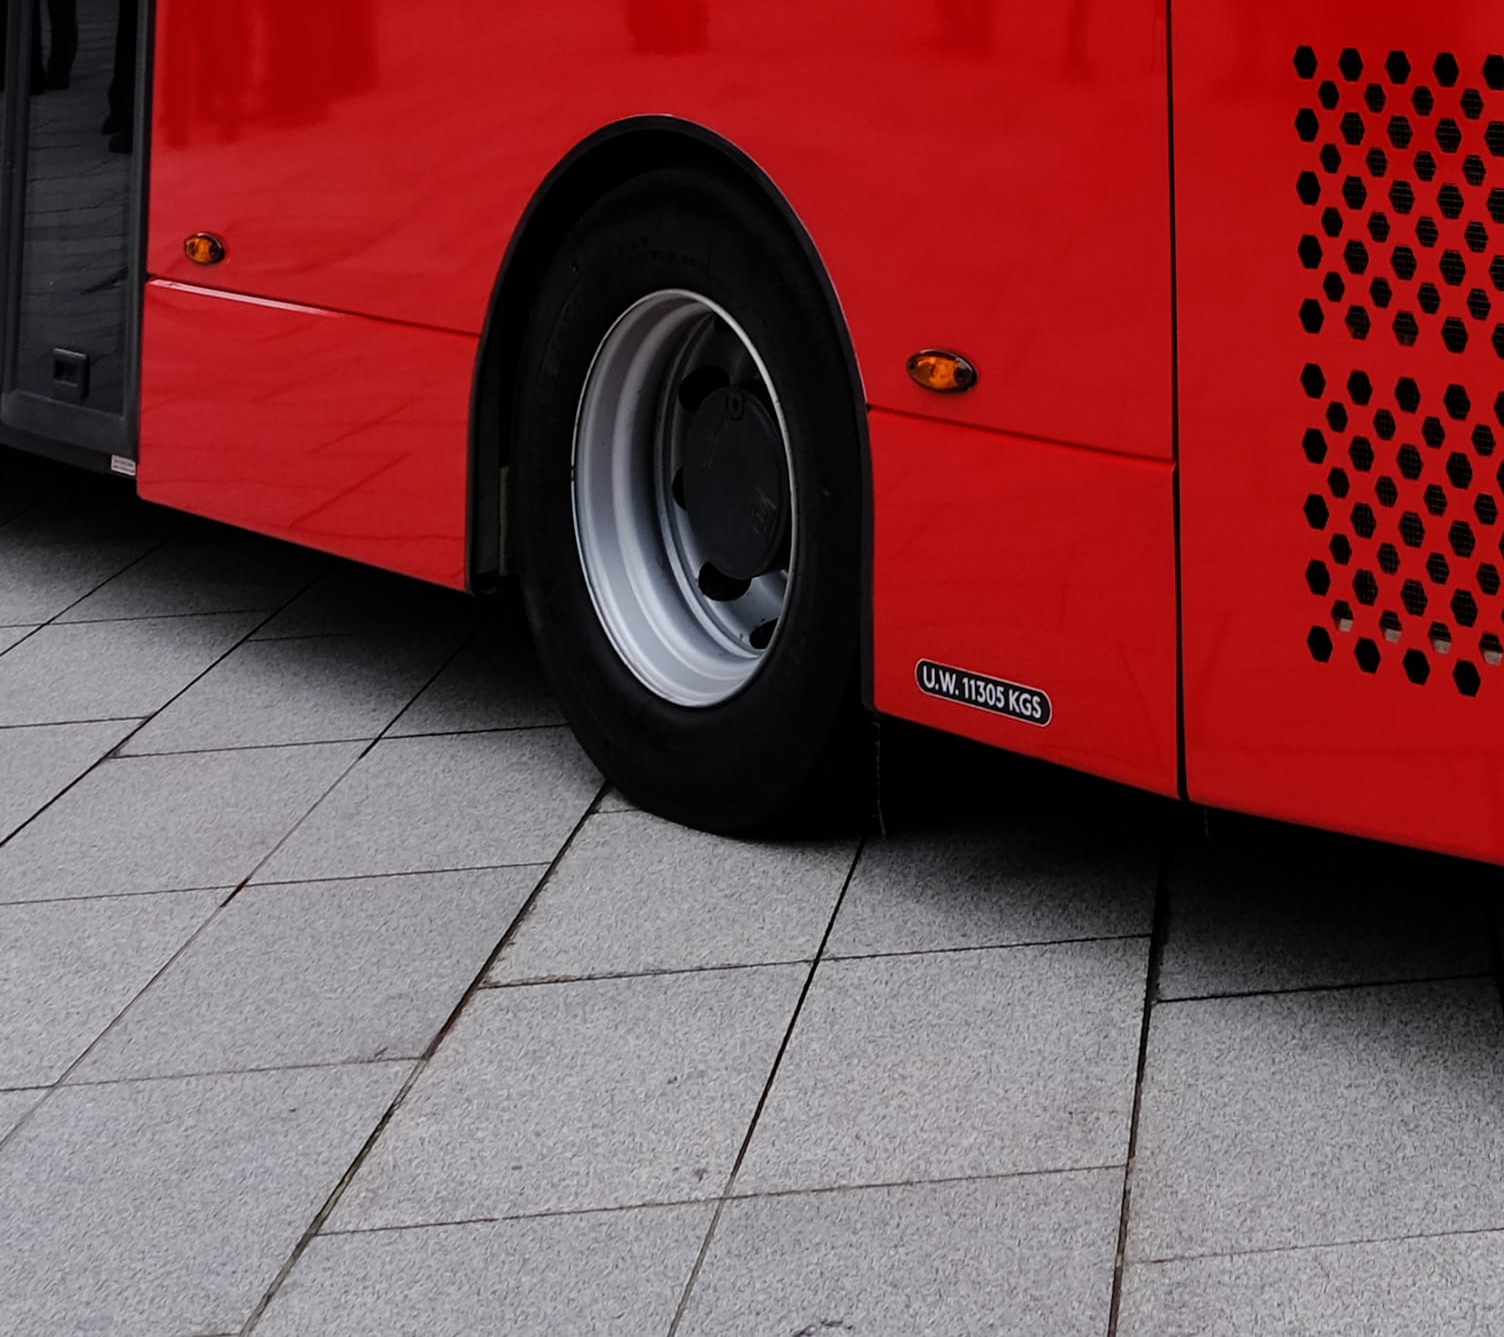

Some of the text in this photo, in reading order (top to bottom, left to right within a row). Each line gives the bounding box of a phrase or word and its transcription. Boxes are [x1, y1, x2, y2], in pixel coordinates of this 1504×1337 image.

[922, 665, 1042, 719] U.W. 11305 KGS
